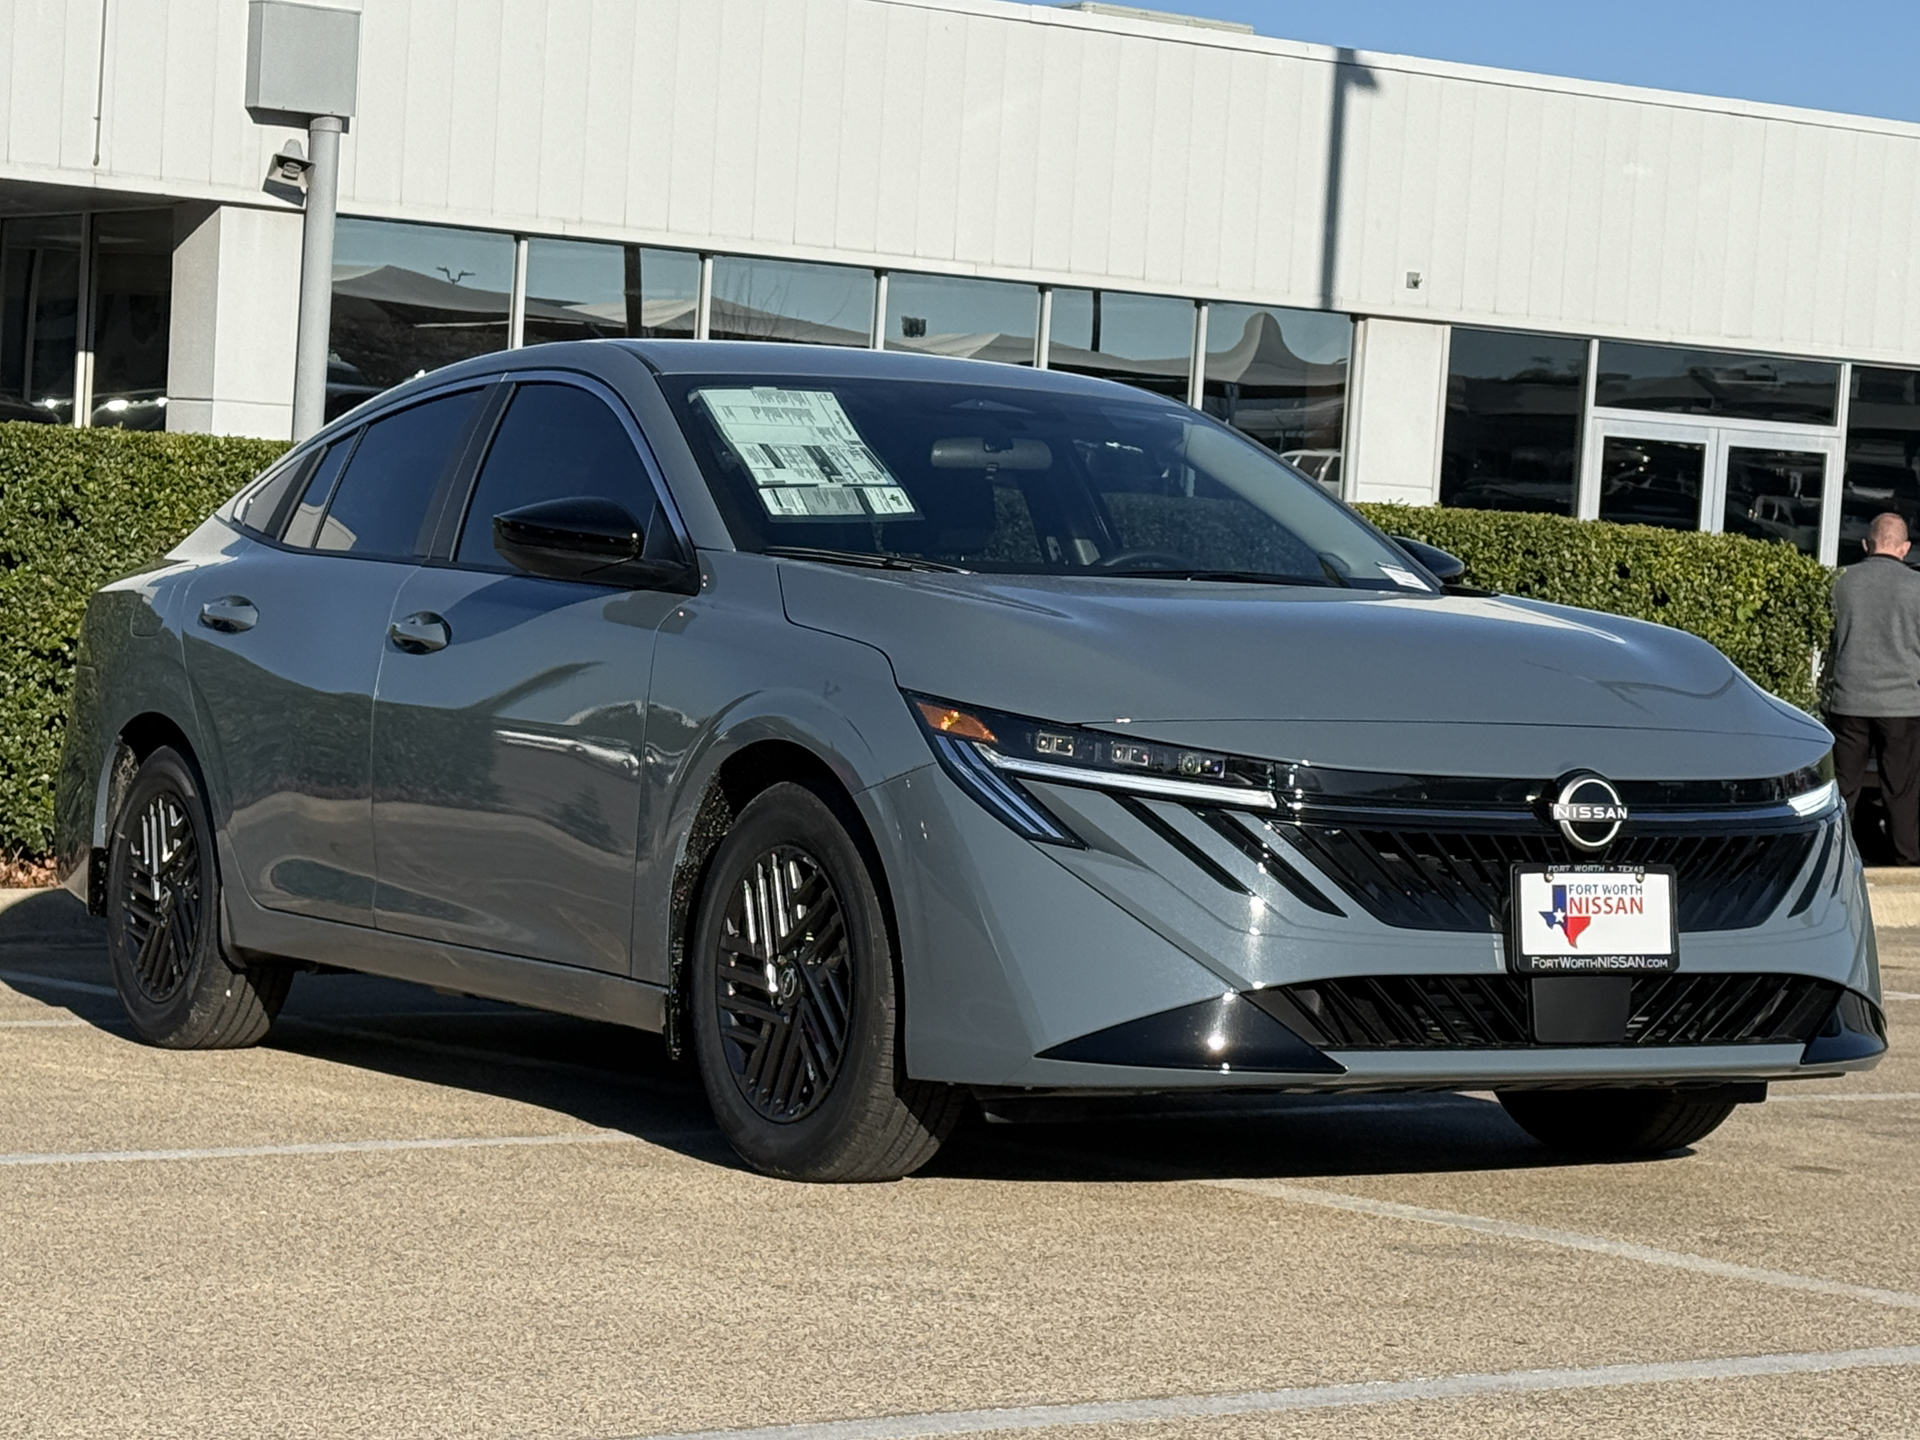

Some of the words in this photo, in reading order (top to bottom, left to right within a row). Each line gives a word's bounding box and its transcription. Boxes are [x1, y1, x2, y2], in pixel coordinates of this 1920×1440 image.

[1556, 806, 1628, 819] NISSAN
[1548, 865, 1570, 873] FORT
[1574, 865, 1605, 873] WORTH
[1617, 866, 1645, 874] TEXAS
[1568, 884, 1599, 895] FORT
[1602, 884, 1643, 895] WORTH
[1569, 896, 1643, 914] NISSAN
